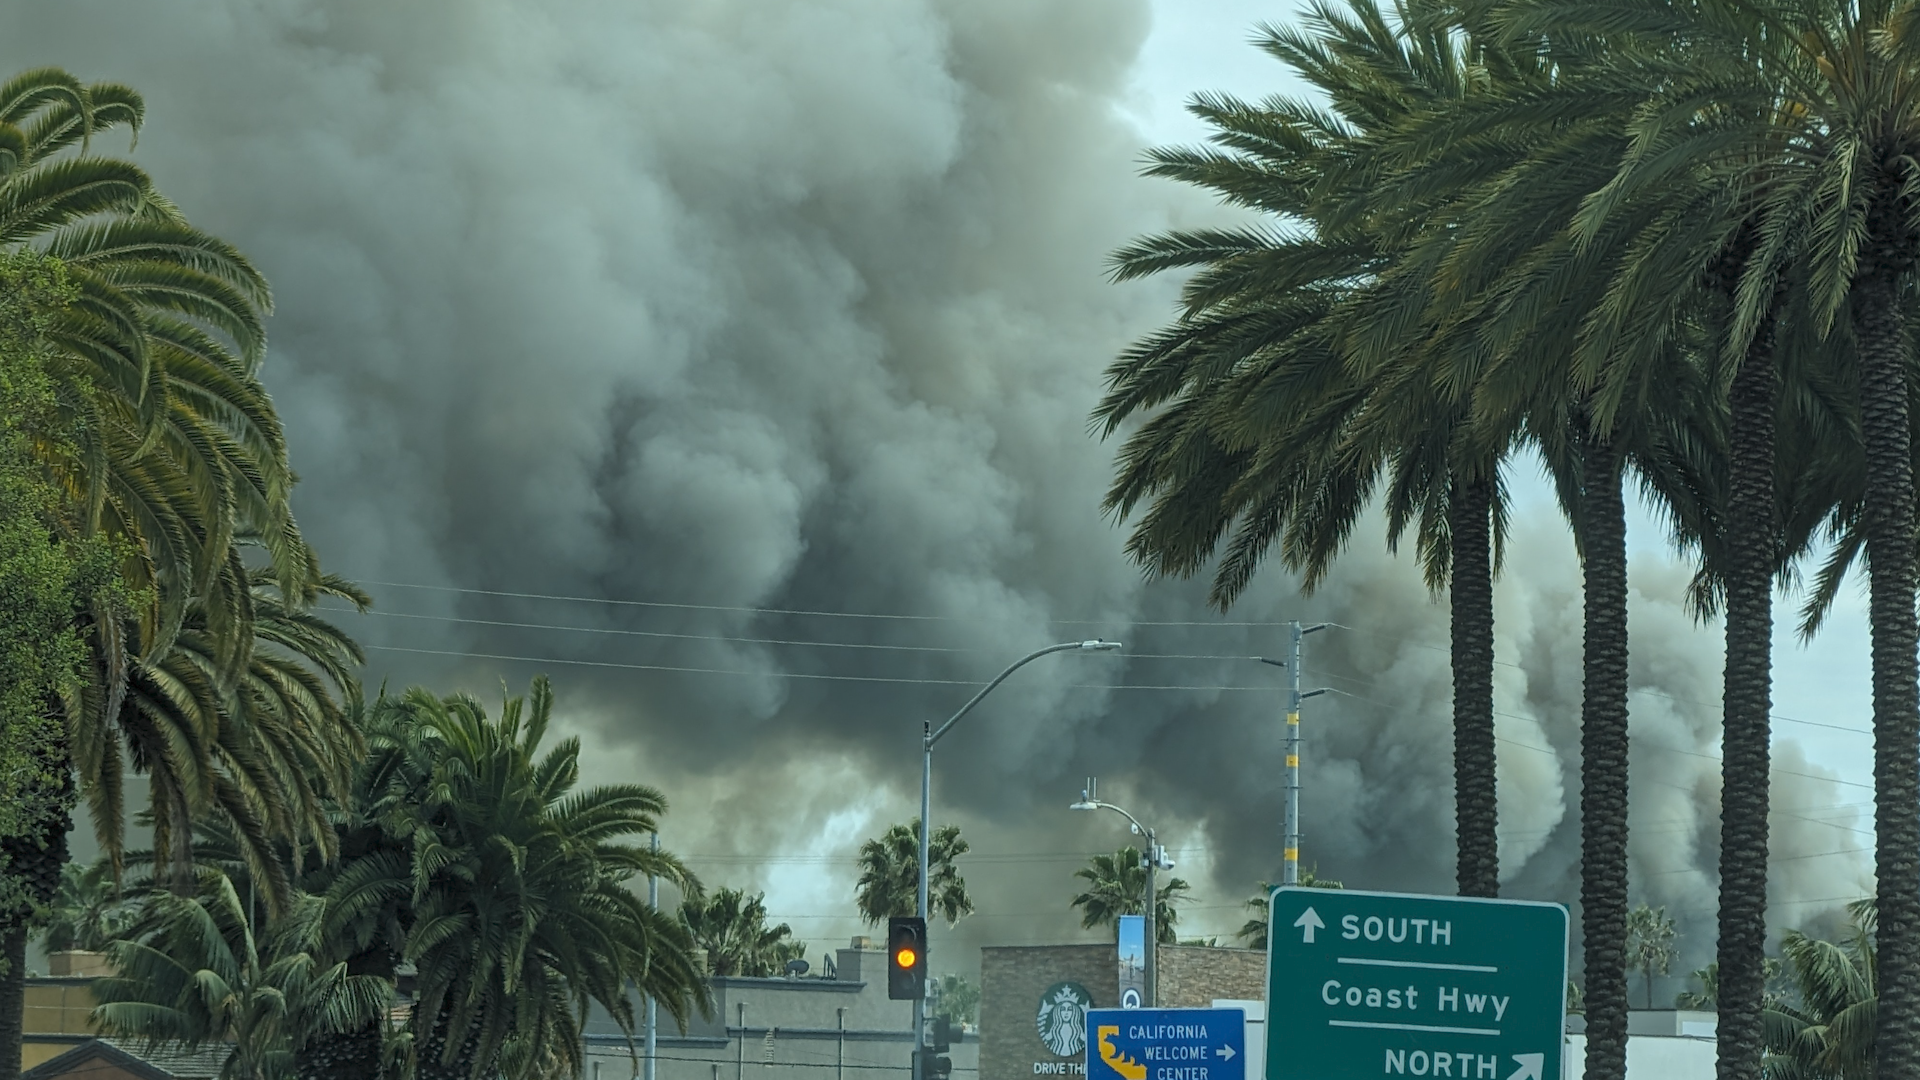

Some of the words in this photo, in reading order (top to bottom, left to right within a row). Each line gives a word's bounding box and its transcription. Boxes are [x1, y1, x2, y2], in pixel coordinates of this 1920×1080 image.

[1341, 914, 1451, 945] SOUTH
[1321, 979, 1418, 1010] Coast
[1438, 986, 1510, 1022] Hwy
[1129, 1025, 1208, 1039] CALIFORNIA
[1144, 1046, 1208, 1060] WELCOME
[1033, 1062, 1066, 1075] DRIVE
[1068, 1062, 1086, 1075] TH
[1384, 1048, 1497, 1080] NORTH
[1157, 1067, 1209, 1080] CENTER
